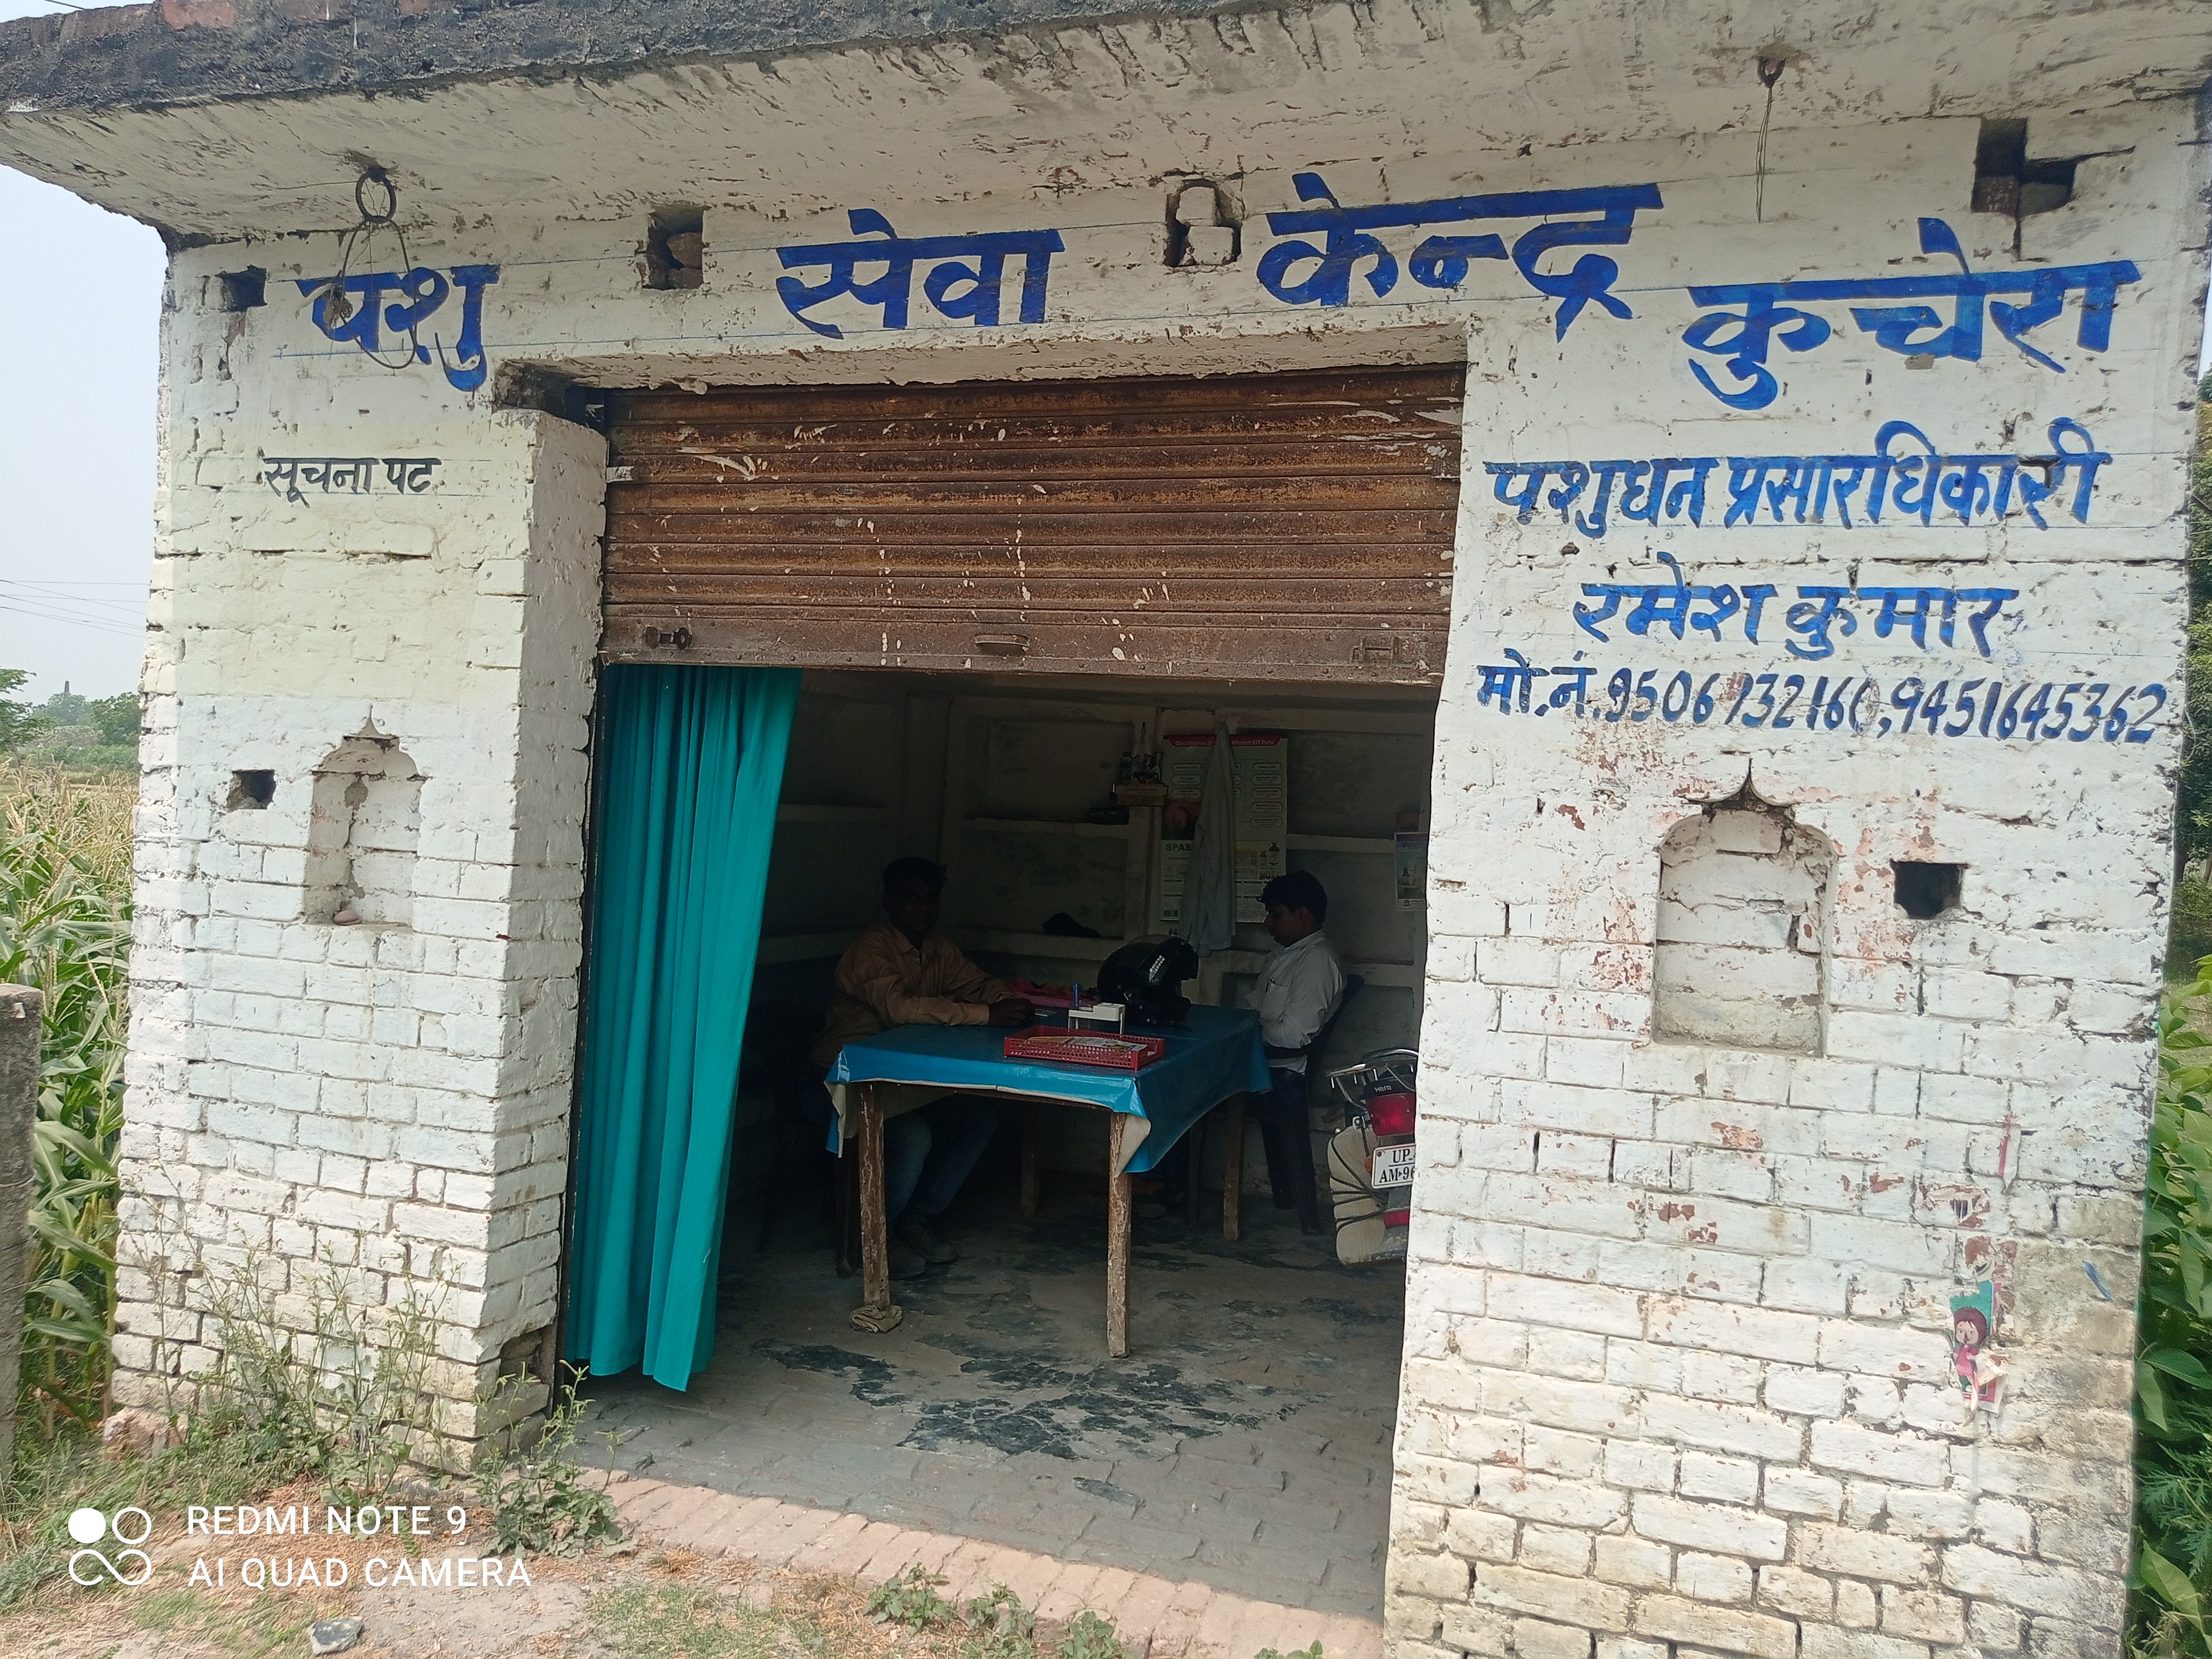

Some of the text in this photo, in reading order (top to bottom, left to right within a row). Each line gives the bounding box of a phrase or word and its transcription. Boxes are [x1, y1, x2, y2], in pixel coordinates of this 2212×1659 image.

[777, 208, 1065, 339] सेवा
[1256, 172, 1664, 343] केन्द्र
[1681, 217, 2142, 410] कुचेरा
[263, 457, 442, 508] सूचना पट
[1483, 457, 1720, 538] पशुधन
[1573, 551, 2020, 661] रमेश कुमार
[1374, 1084, 1392, 1093] Hero
